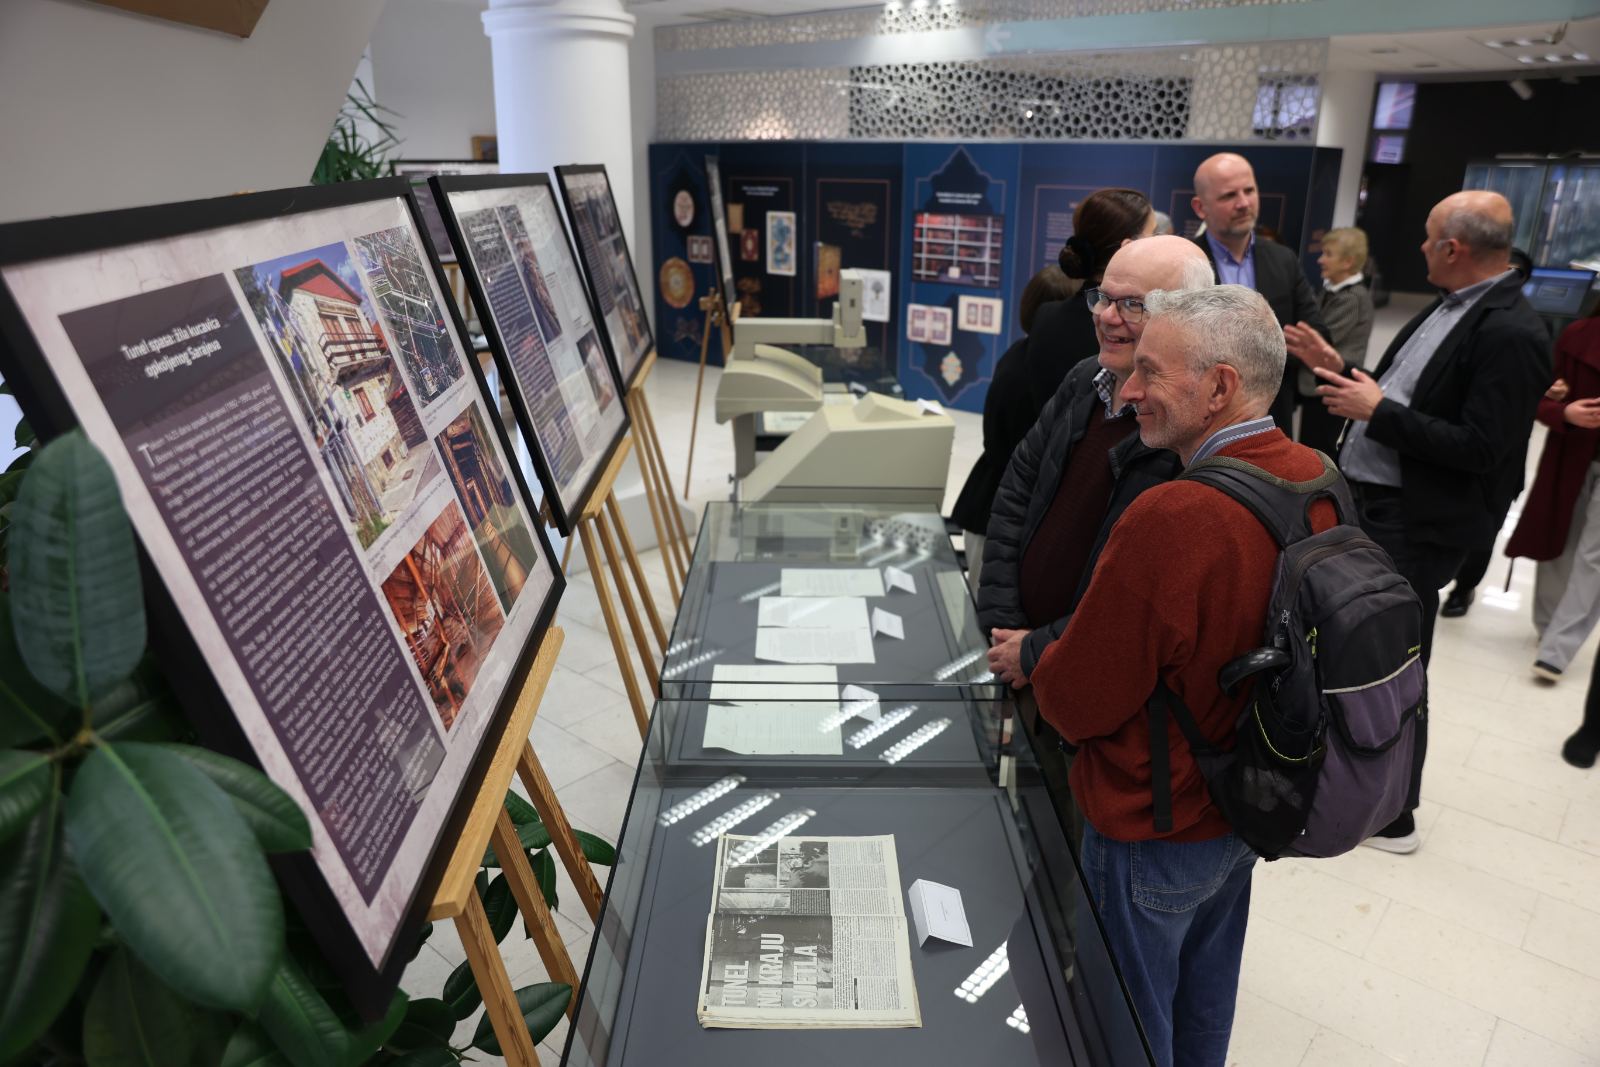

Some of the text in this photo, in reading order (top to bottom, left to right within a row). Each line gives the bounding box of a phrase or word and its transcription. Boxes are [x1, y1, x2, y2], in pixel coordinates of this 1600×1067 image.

[121, 318, 221, 360] Tunel spasa: žila kucavica
[145, 340, 221, 378] opkoljenog Sarajeva
[759, 933, 784, 985] KRAJU
[792, 945, 818, 1008] SVJETLA
[722, 961, 749, 1007] TUNEL
